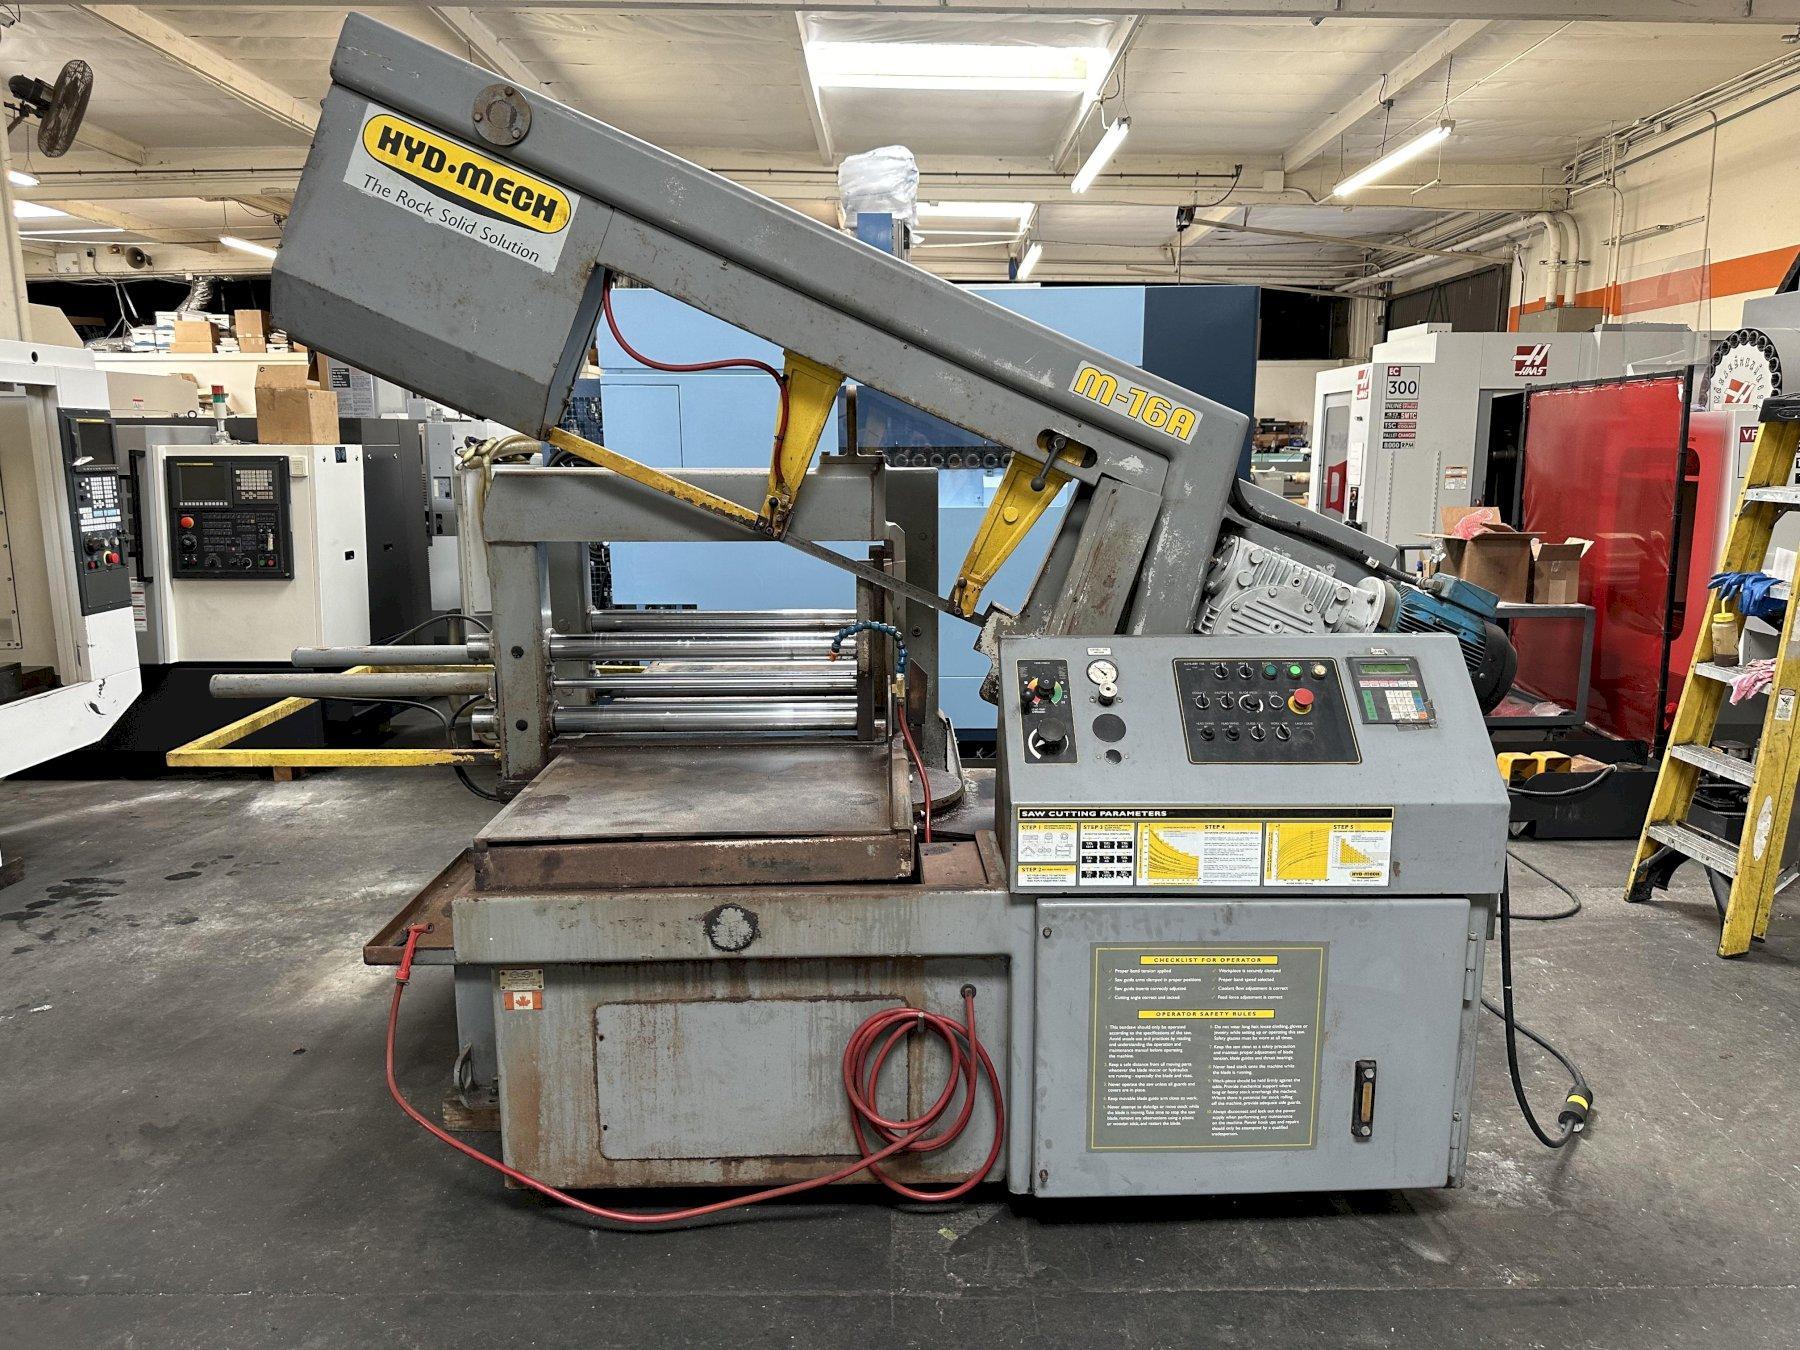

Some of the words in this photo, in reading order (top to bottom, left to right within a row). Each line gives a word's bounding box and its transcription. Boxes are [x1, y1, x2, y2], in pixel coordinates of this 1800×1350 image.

[363, 174, 391, 198] The
[396, 189, 433, 218] Rock
[439, 209, 478, 235] Solid
[480, 226, 539, 263] Solution
[1388, 381, 1417, 394] 300
[1515, 367, 1547, 375] HAAS
[1073, 367, 1196, 440] M-16A
